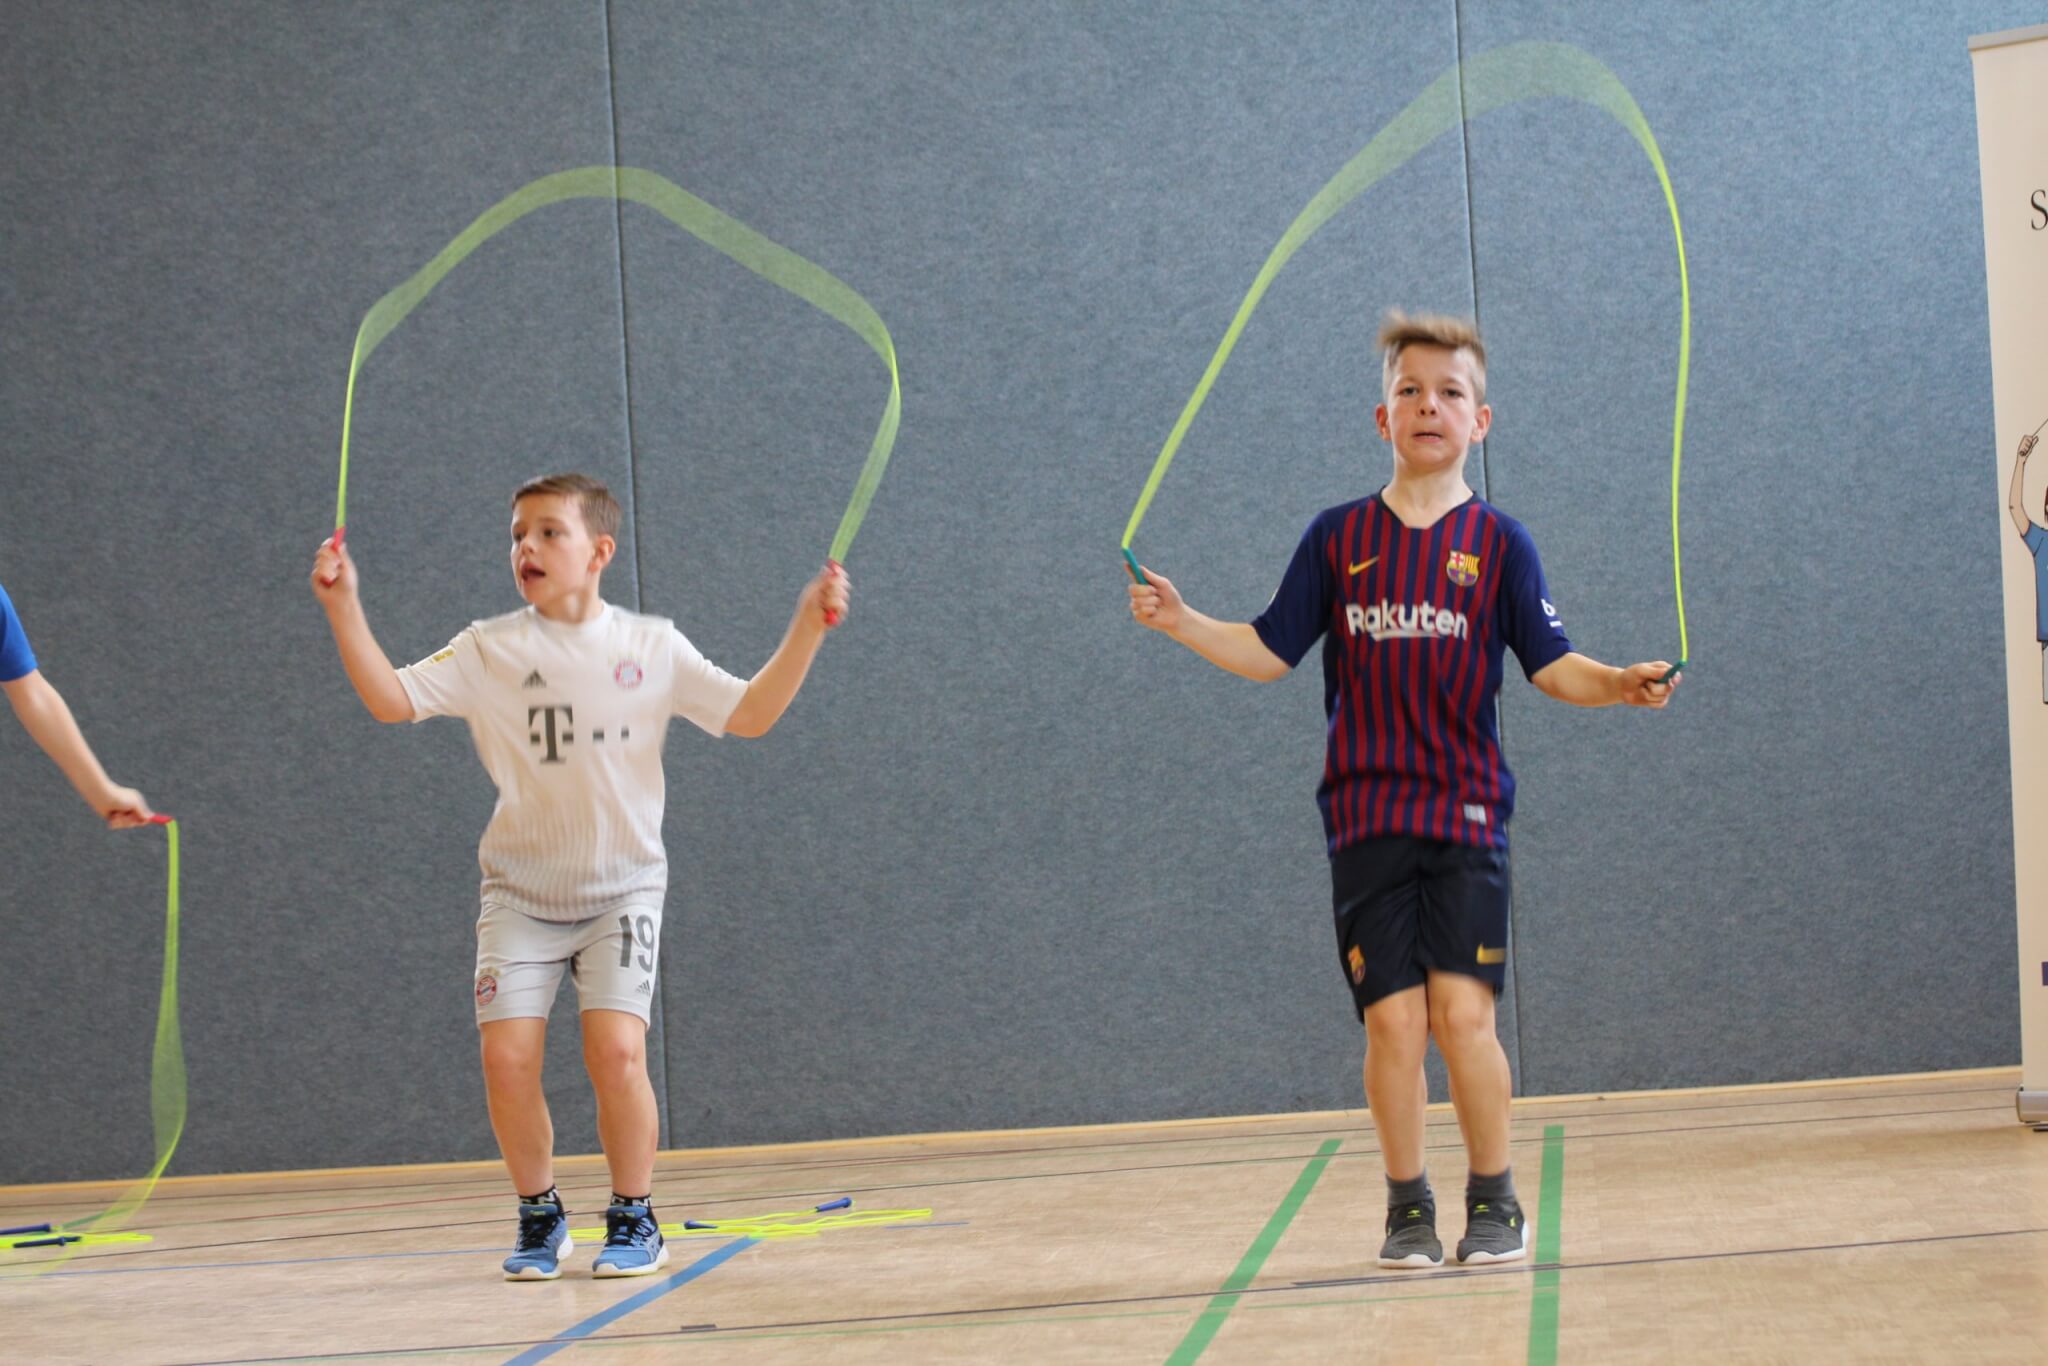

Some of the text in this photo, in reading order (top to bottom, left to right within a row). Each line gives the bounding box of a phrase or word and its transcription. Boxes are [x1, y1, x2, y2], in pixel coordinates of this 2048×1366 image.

[2030, 189, 2048, 231] S
[1345, 598, 1468, 641] Rakuten
[619, 914, 655, 973] 19
